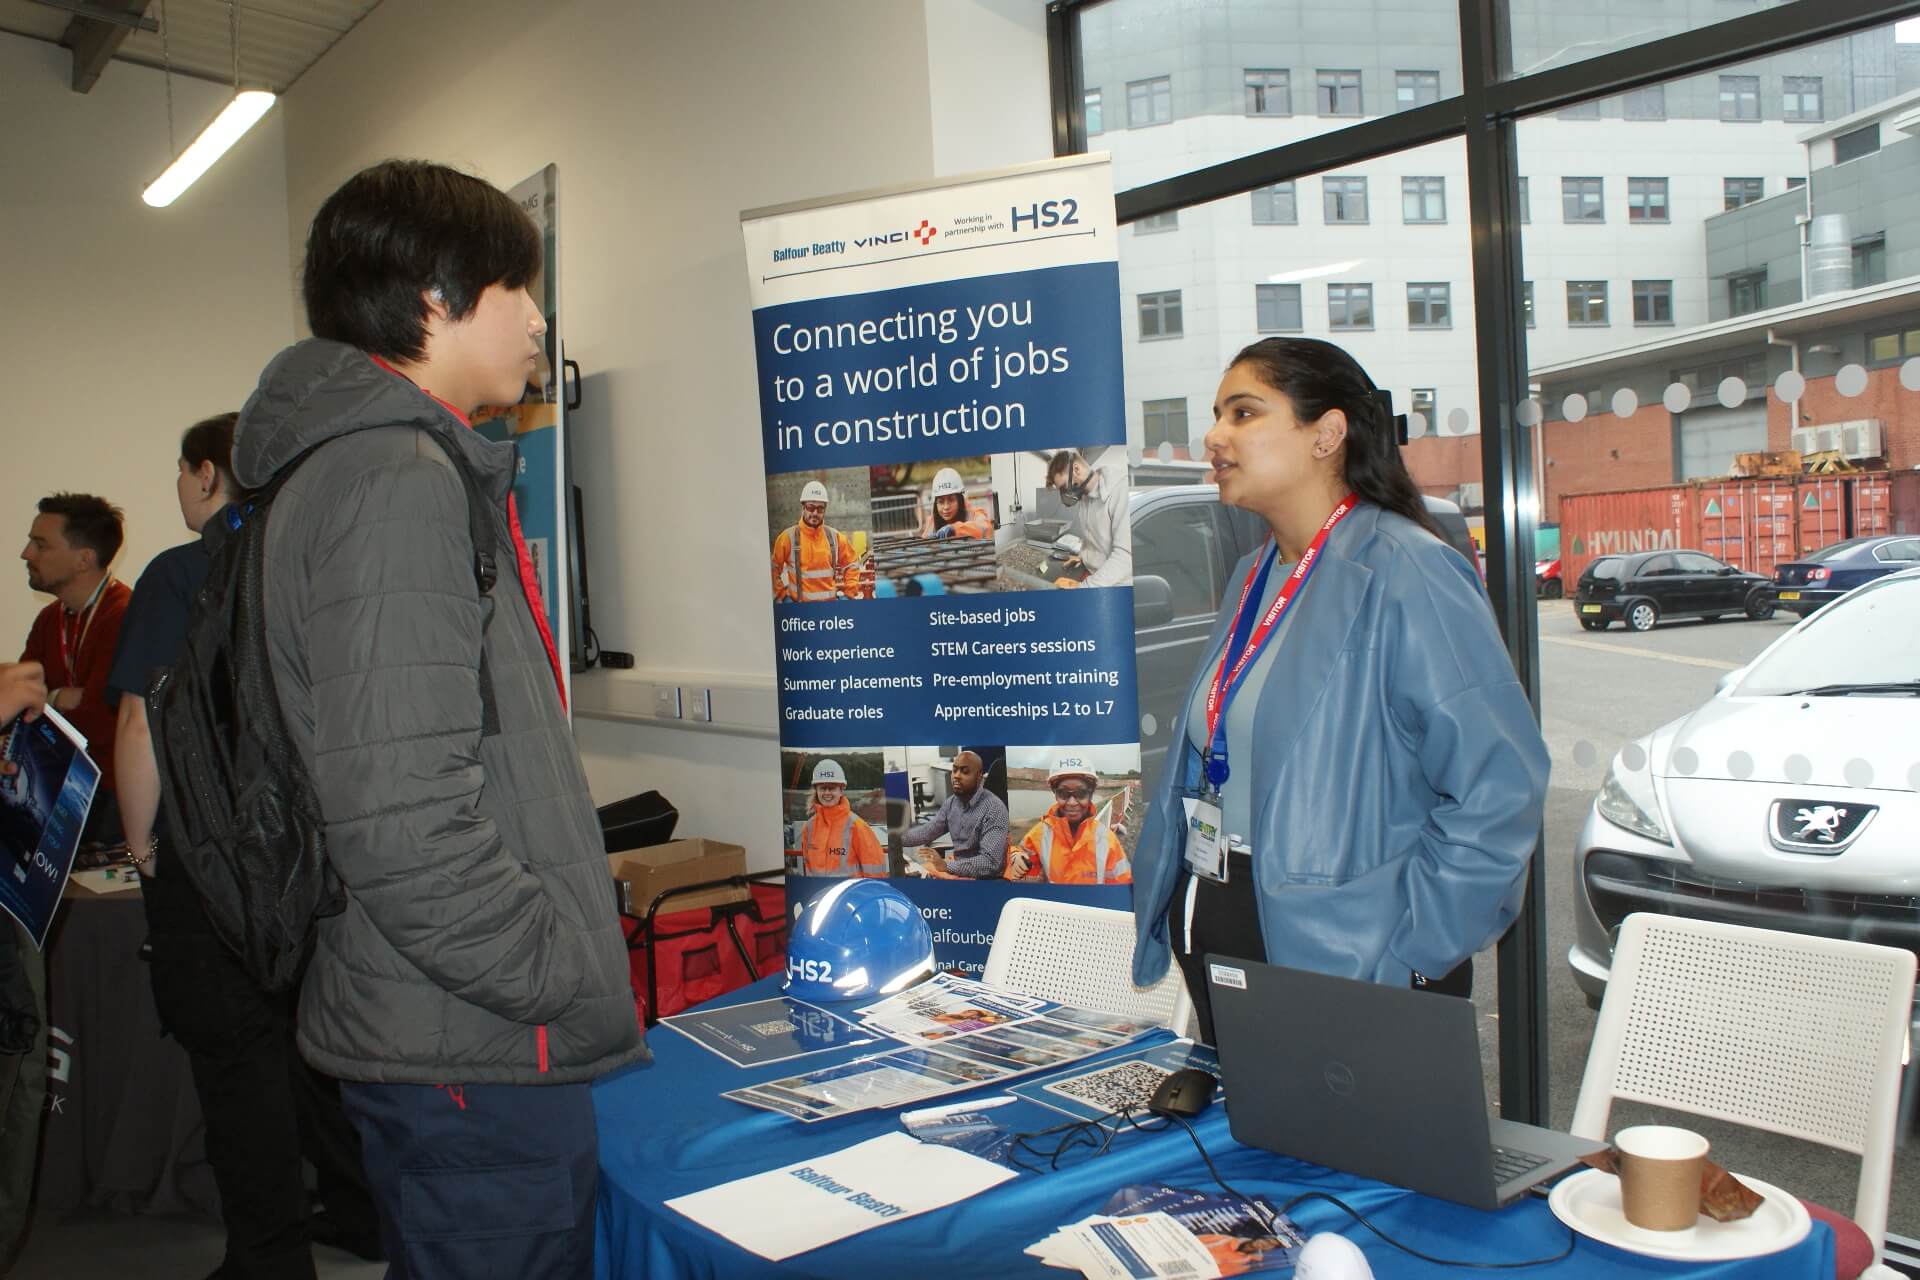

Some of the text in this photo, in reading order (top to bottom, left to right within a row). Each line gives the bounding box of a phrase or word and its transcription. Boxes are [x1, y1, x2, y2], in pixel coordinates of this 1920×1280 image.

[953, 213, 993, 226] Working in
[1011, 198, 1079, 233] HS2
[854, 231, 909, 248] VINCI
[944, 222, 1004, 239] partnership with
[773, 240, 846, 263] Balfour Beatty
[773, 299, 1032, 355] Connecting you
[774, 342, 1069, 402] to a world of jobs
[777, 400, 1026, 451] in construction
[1322, 503, 1349, 531] VISITOR
[1587, 527, 1681, 555] HYUNDAI
[1292, 547, 1316, 580] VISITOR
[929, 608, 1036, 627] Site-based jobs
[1263, 595, 1287, 628] VISITOR
[781, 616, 855, 632] Office roles
[782, 645, 895, 663] Work experience
[931, 638, 1096, 656] STEM Careers sessions
[1233, 644, 1257, 674] VISITOR
[784, 674, 923, 693] Summer placements
[933, 669, 1119, 690] Pre-employment training
[785, 705, 884, 720] Graduate roles
[934, 700, 1114, 721] Apprenticeships L2 to L7
[1059, 758, 1082, 768] HS2
[829, 847, 847, 856] HS2
[932, 928, 994, 945] alfourbe
[789, 956, 833, 983] HS2
[934, 960, 985, 974] nal Care
[789, 1167, 908, 1217] Balfour Beatty
